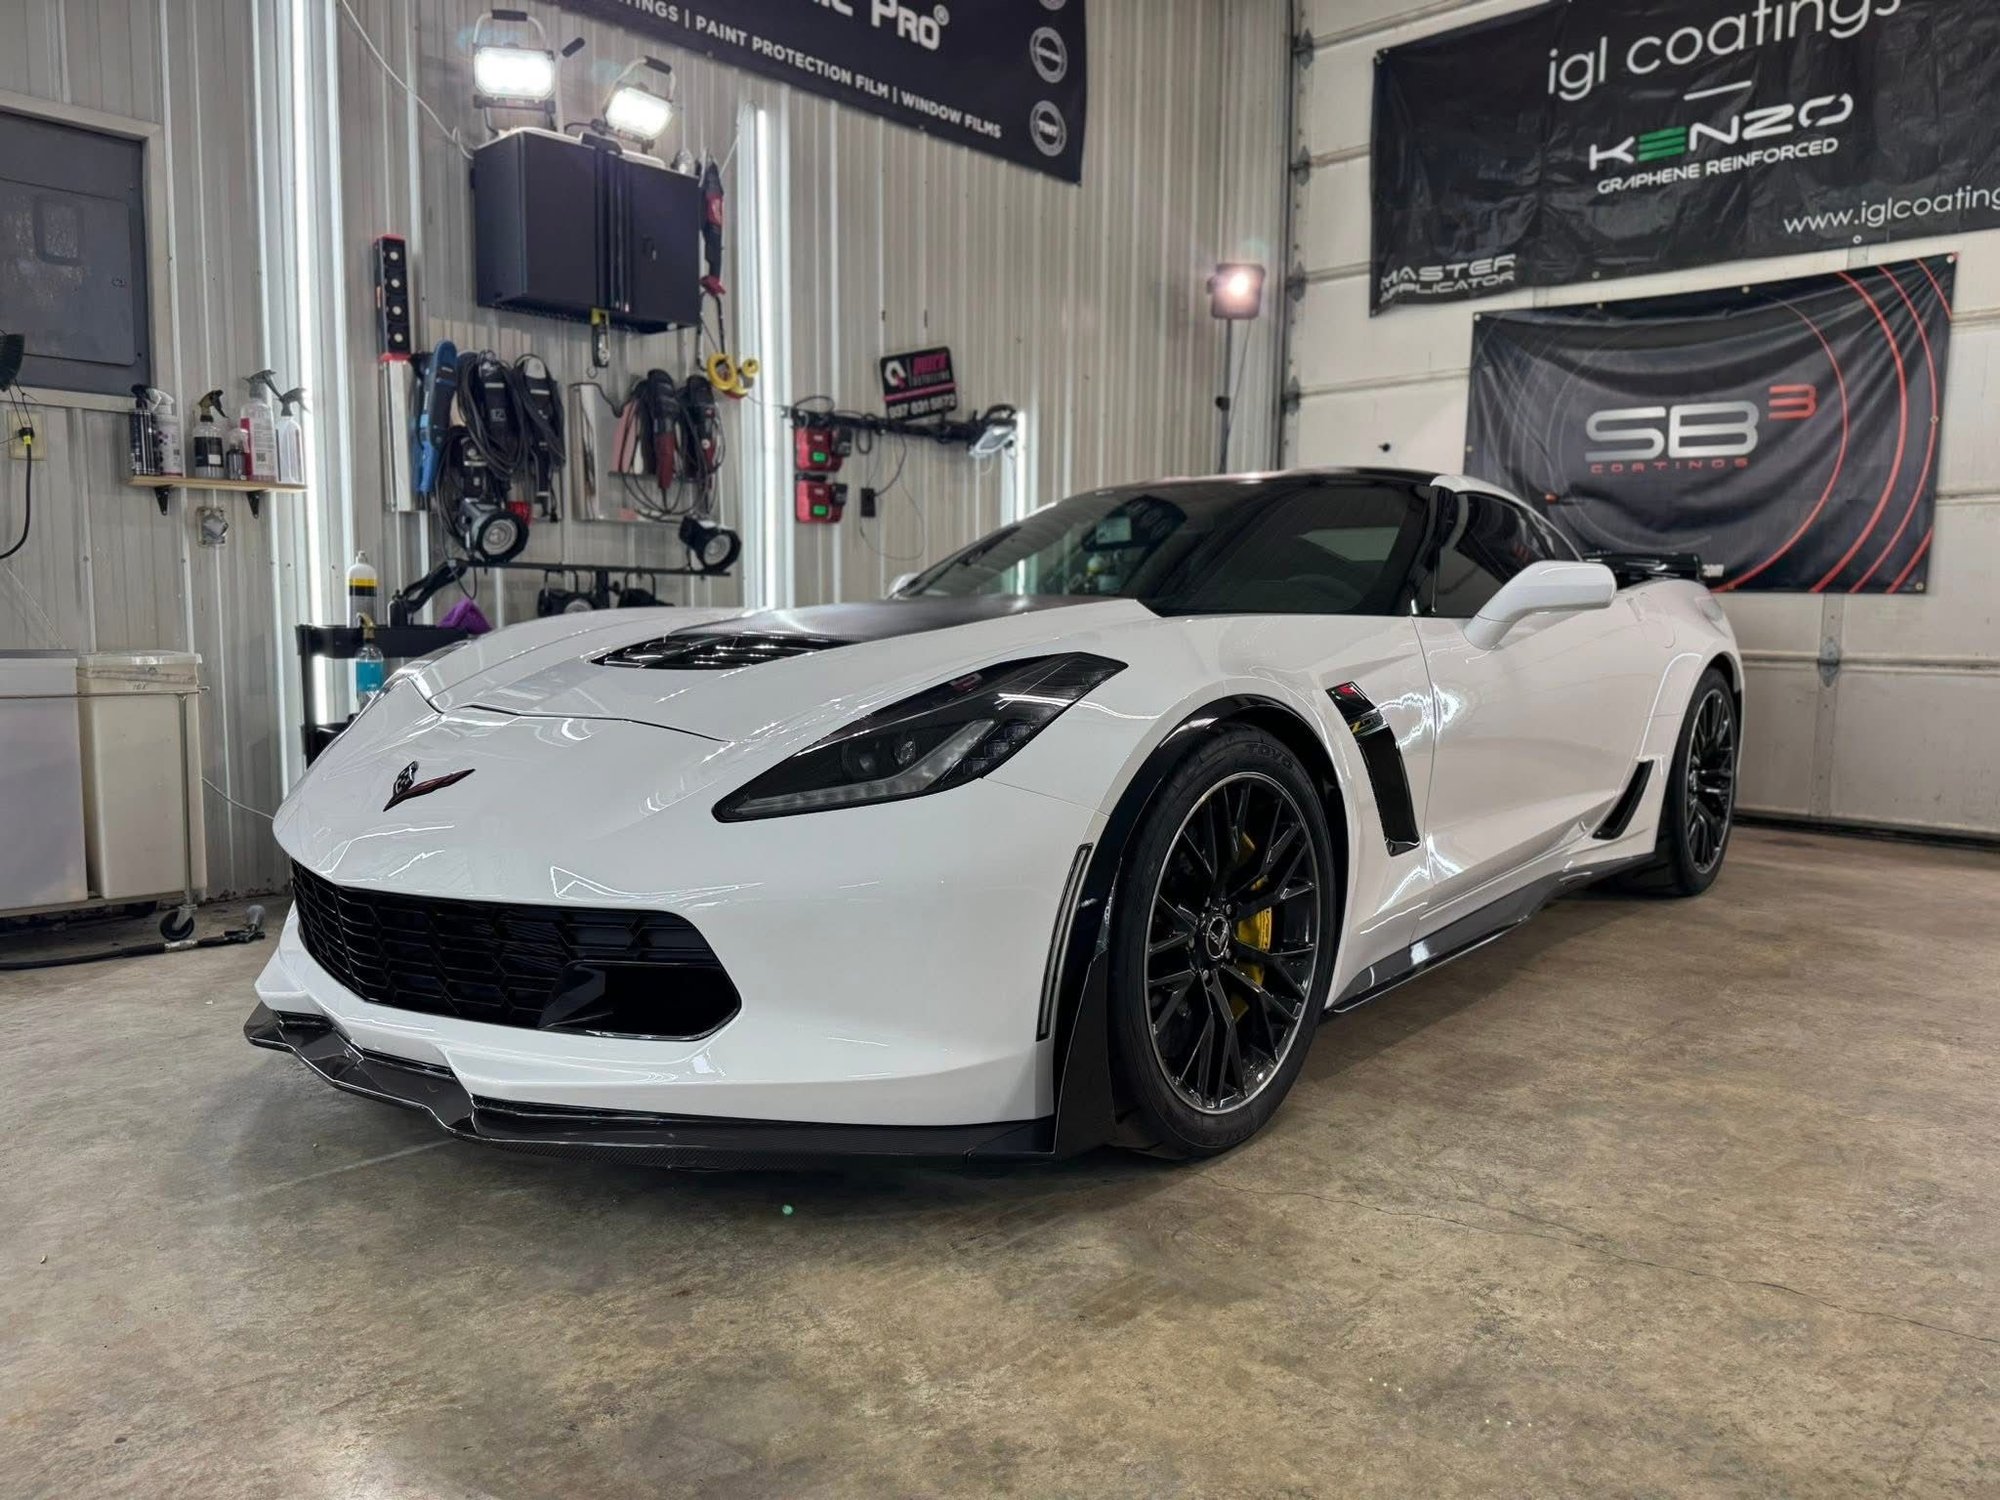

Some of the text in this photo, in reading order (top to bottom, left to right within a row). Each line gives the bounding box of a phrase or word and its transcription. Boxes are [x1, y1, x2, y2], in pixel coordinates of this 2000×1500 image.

[618, 0, 680, 22] INGS
[695, 15, 748, 47] PAINT
[751, 36, 852, 85] PROTECTION
[855, 74, 889, 99] FILM
[900, 91, 962, 125] WINDOW
[964, 115, 1002, 139] FILMS
[1548, 36, 1608, 101] igl
[1589, 93, 1854, 171] KENZO
[1597, 138, 1839, 195] GRAPHENE REINFORCED
[1380, 253, 1517, 290] MASTER
[1590, 457, 1749, 474] COATINGS
